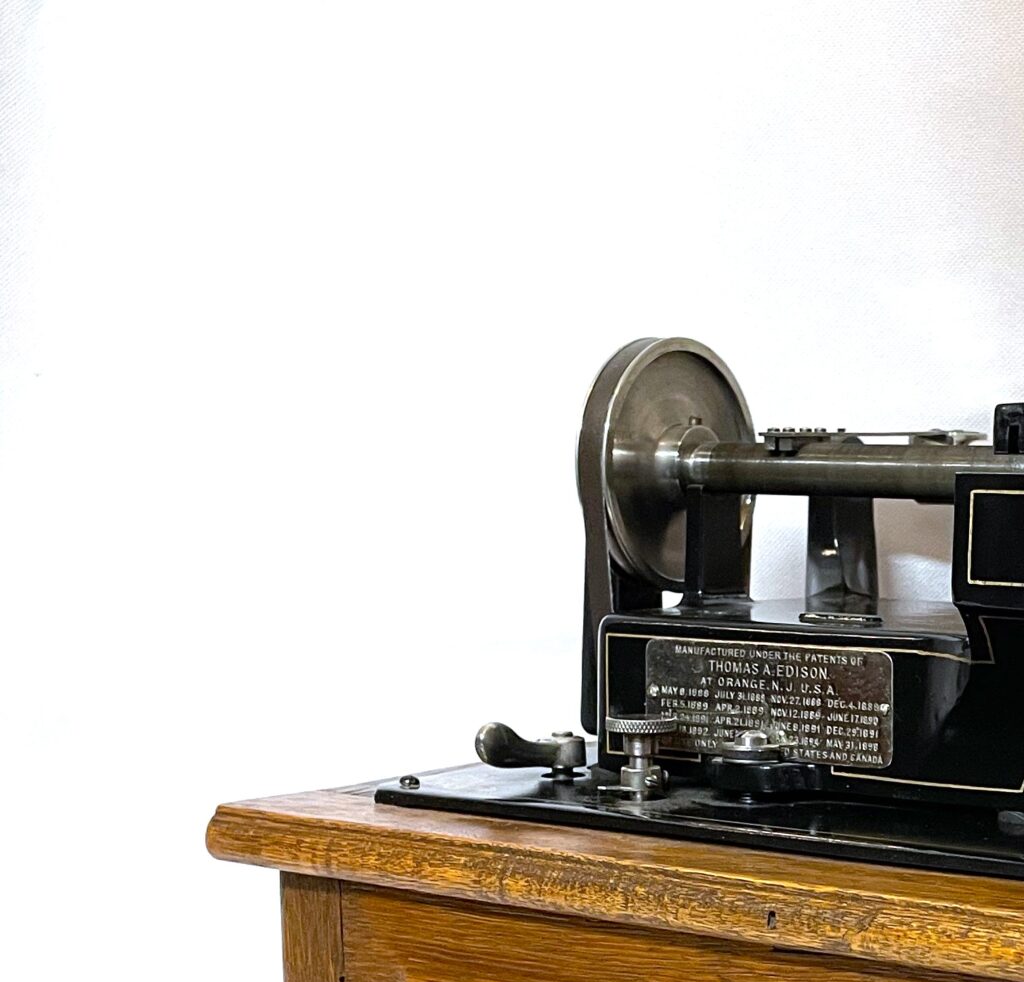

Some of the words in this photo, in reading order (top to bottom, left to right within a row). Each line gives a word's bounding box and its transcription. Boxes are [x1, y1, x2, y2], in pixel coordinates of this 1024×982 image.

[675, 645, 746, 657] MANUFACTURED
[749, 650, 781, 660] UNDER
[783, 652, 801, 661] THE
[805, 653, 847, 665] PATENTS
[709, 660, 759, 675] THOMAS
[700, 677, 712, 686] AT
[829, 751, 848, 761] AND
[850, 754, 883, 764] CANADA
